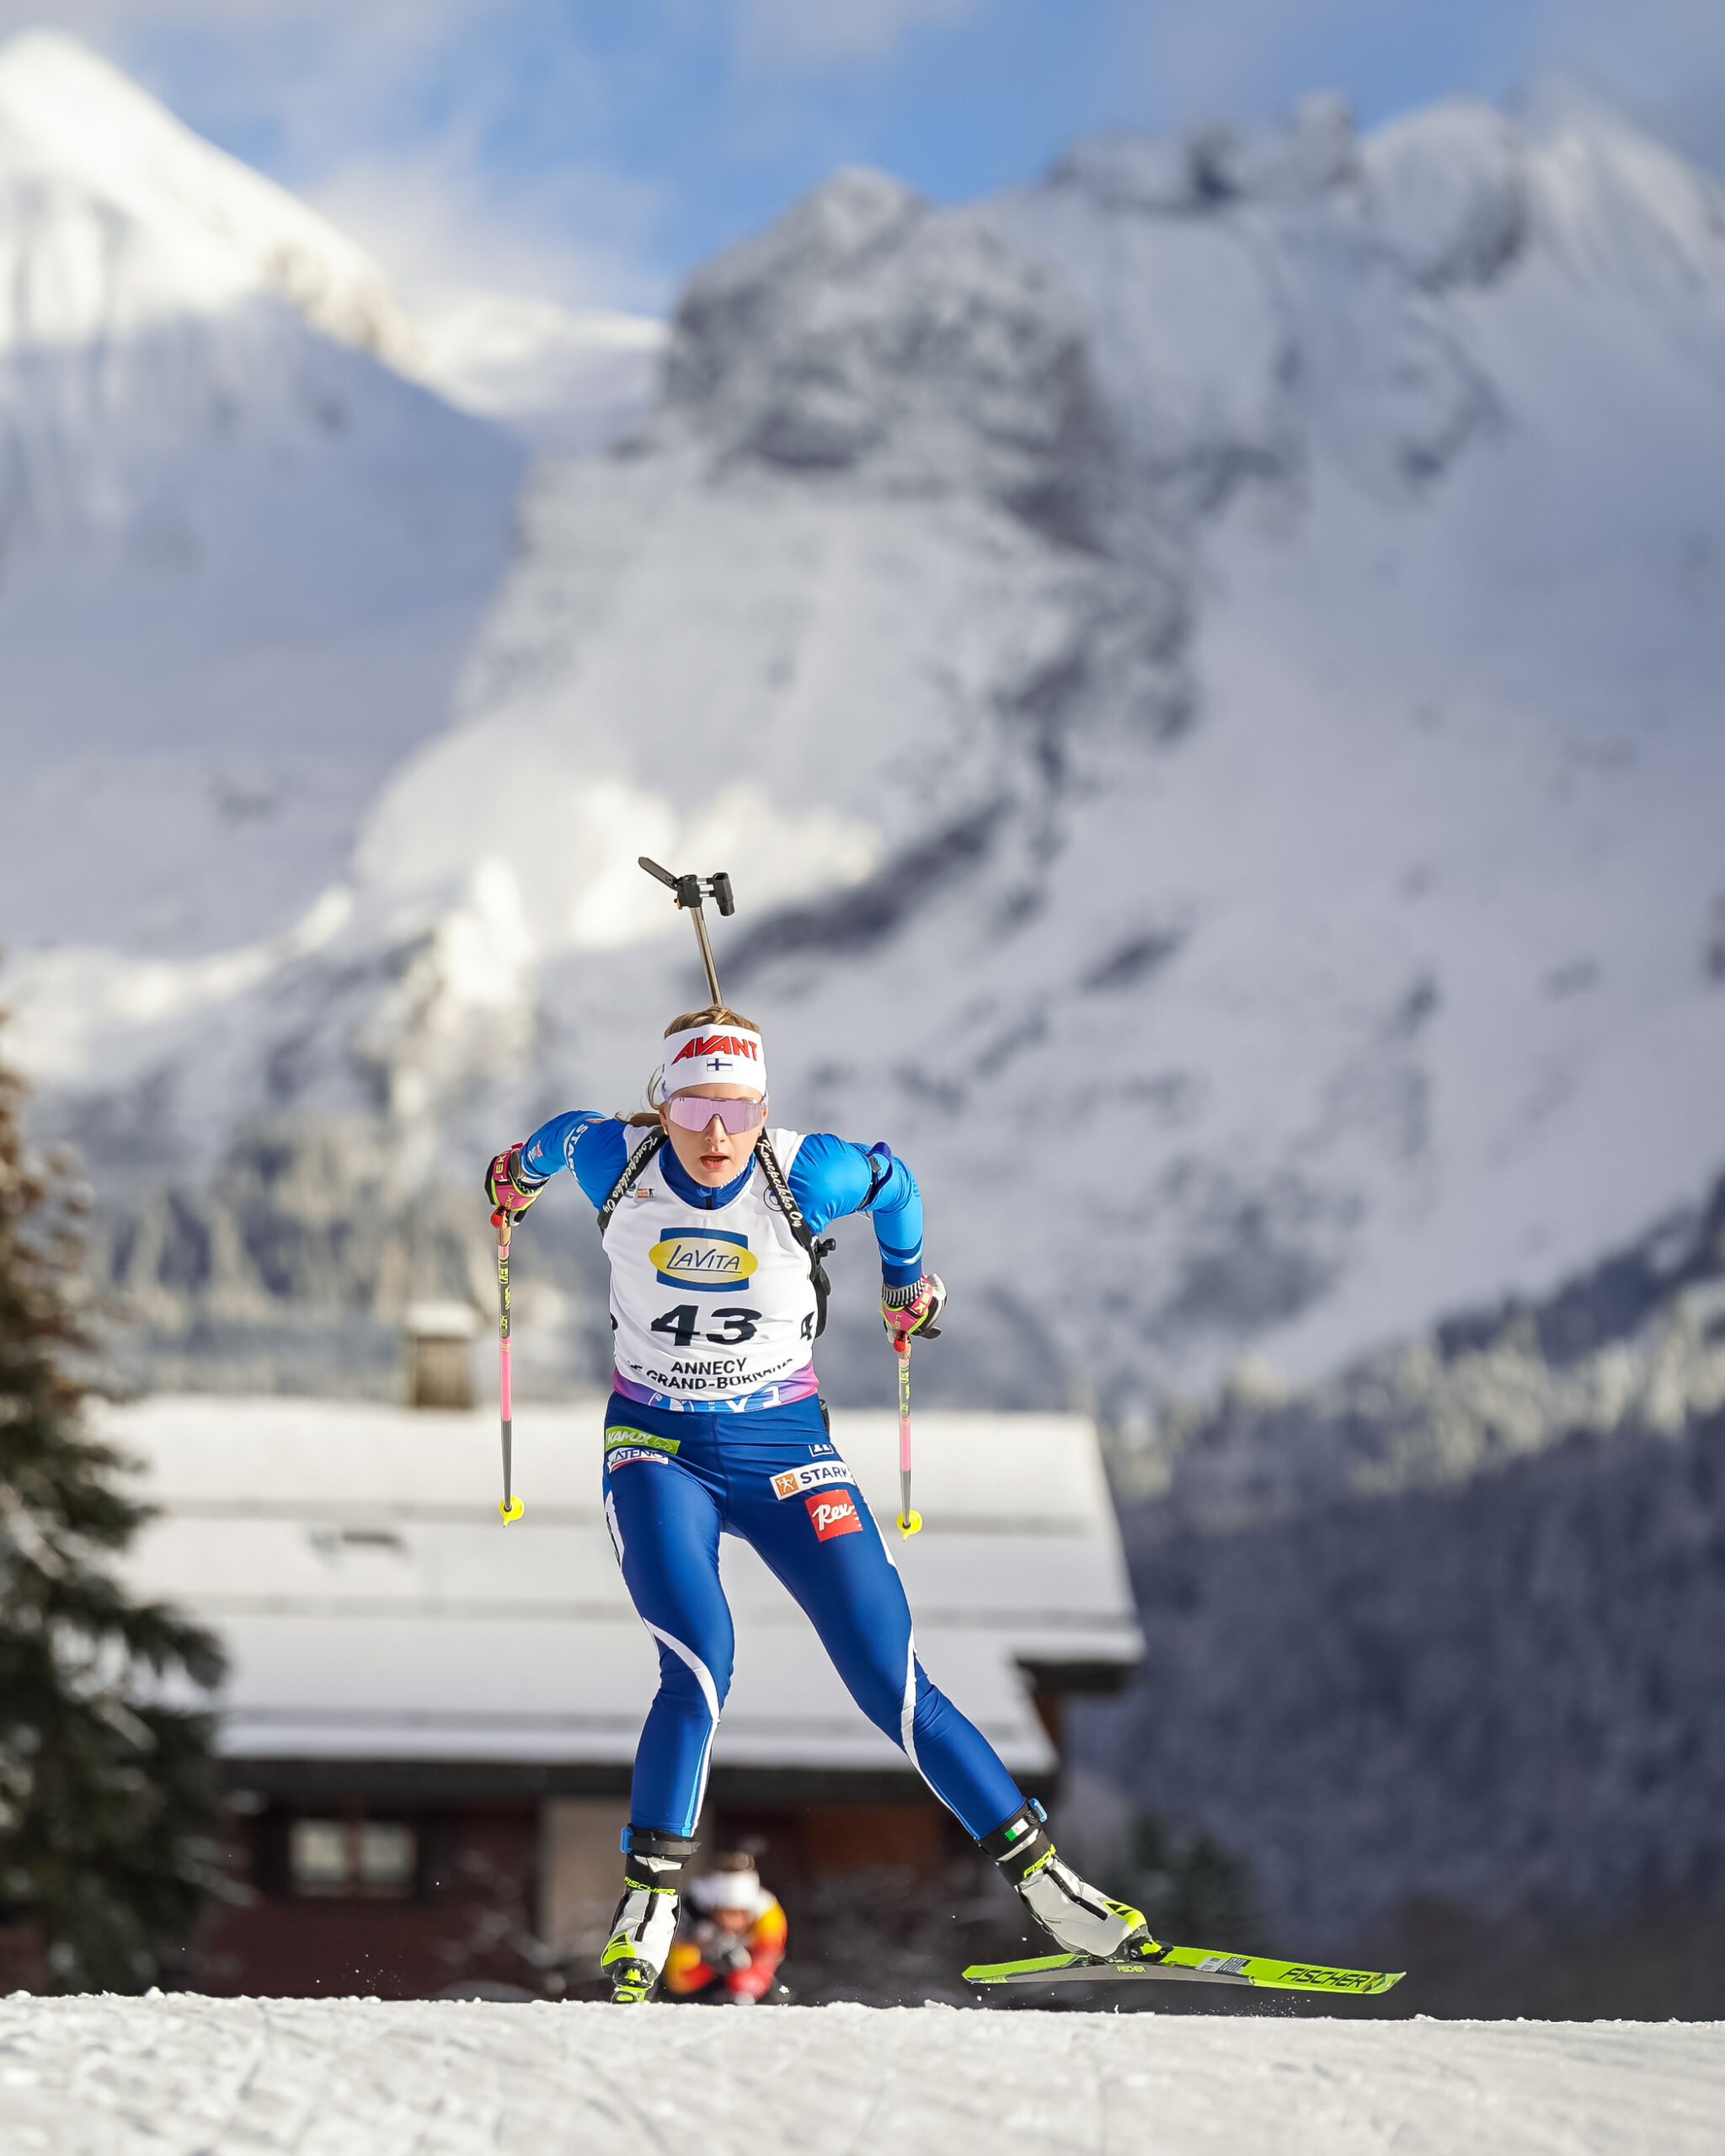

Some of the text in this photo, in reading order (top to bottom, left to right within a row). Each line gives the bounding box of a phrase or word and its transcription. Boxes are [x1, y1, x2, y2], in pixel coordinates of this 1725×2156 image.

[670, 1035, 757, 1065] AVANT
[756, 1139, 804, 1228] Konepeikko Oy
[505, 1192, 515, 1209] EKI
[651, 1305, 762, 1346] 43
[670, 1358, 747, 1375] ANNECY
[607, 1431, 653, 1446] KAMUX
[624, 1876, 676, 1895] FISCHER
[1278, 1967, 1369, 1988] FISCHER
